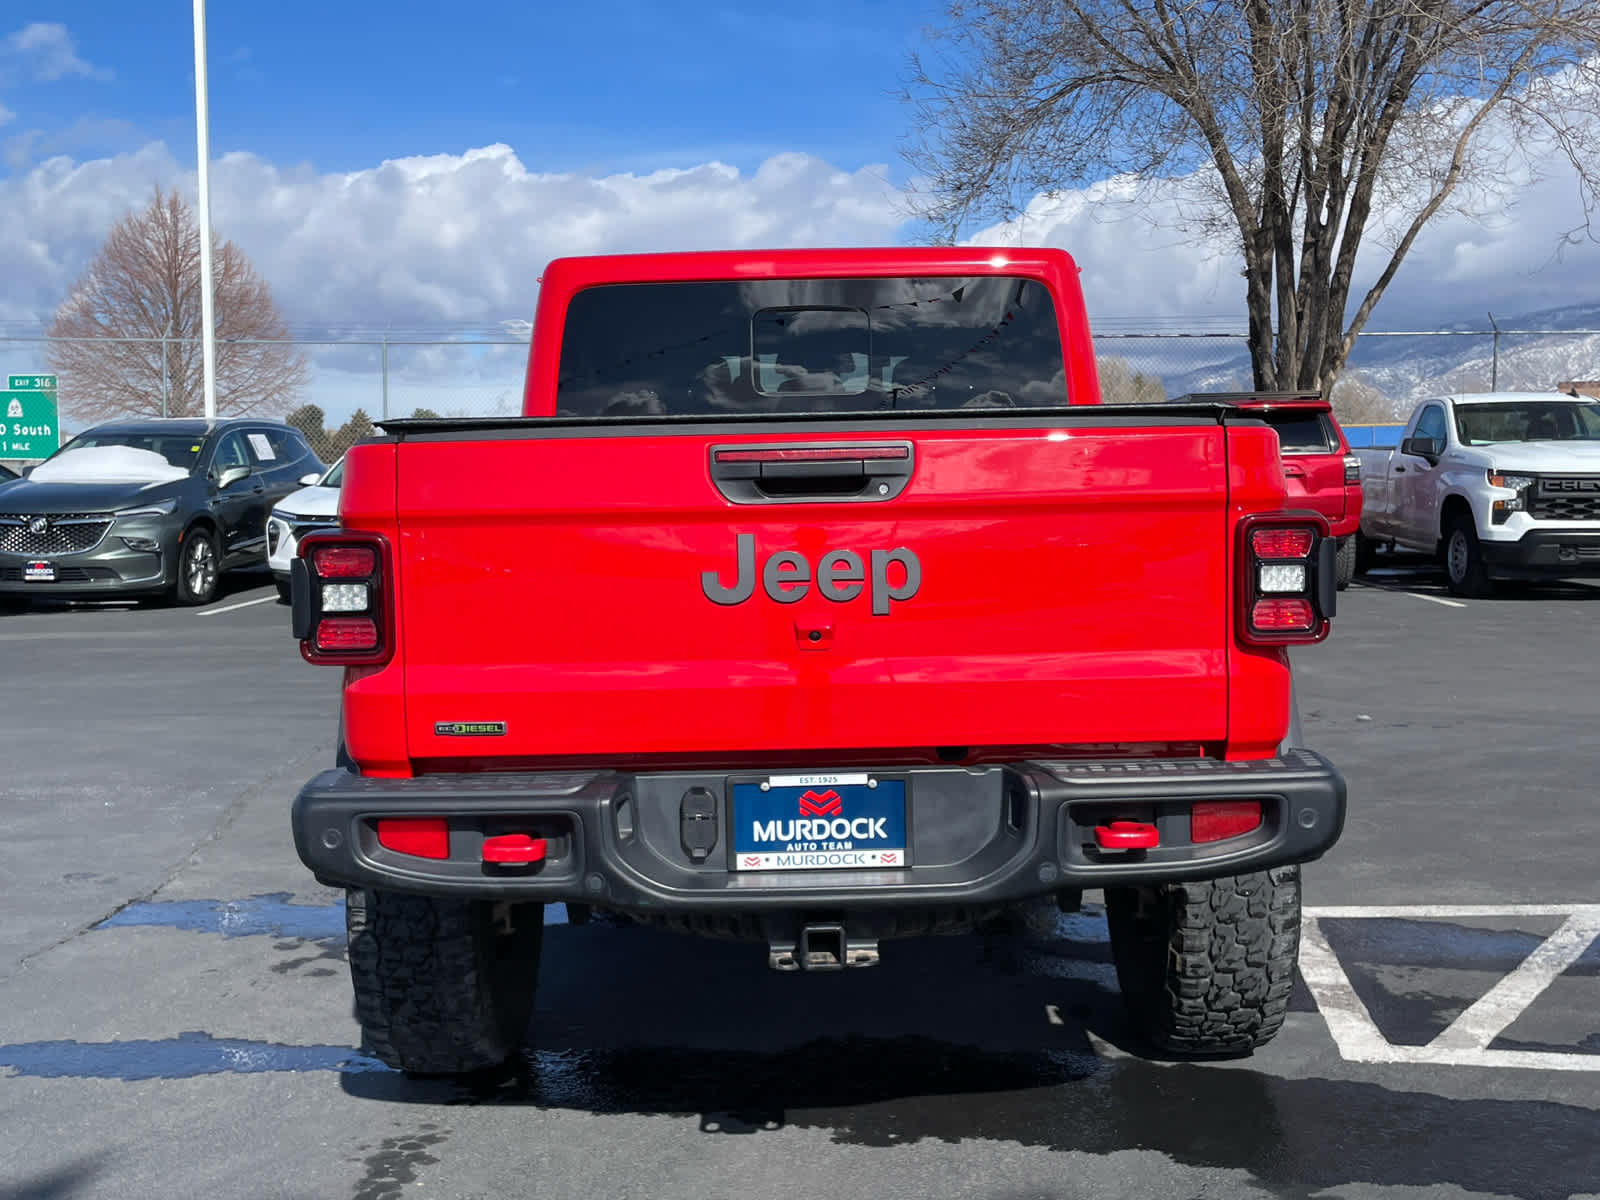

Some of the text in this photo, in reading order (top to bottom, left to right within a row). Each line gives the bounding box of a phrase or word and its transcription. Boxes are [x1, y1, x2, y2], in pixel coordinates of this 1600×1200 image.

[34, 378, 50, 388] 316
[13, 424, 51, 436] South
[2, 441, 7, 452] 1
[701, 533, 921, 615] Jeep
[753, 817, 888, 842] MURDOCK
[786, 841, 853, 851] AUTO TEAM
[776, 853, 866, 866] MURDOCK
